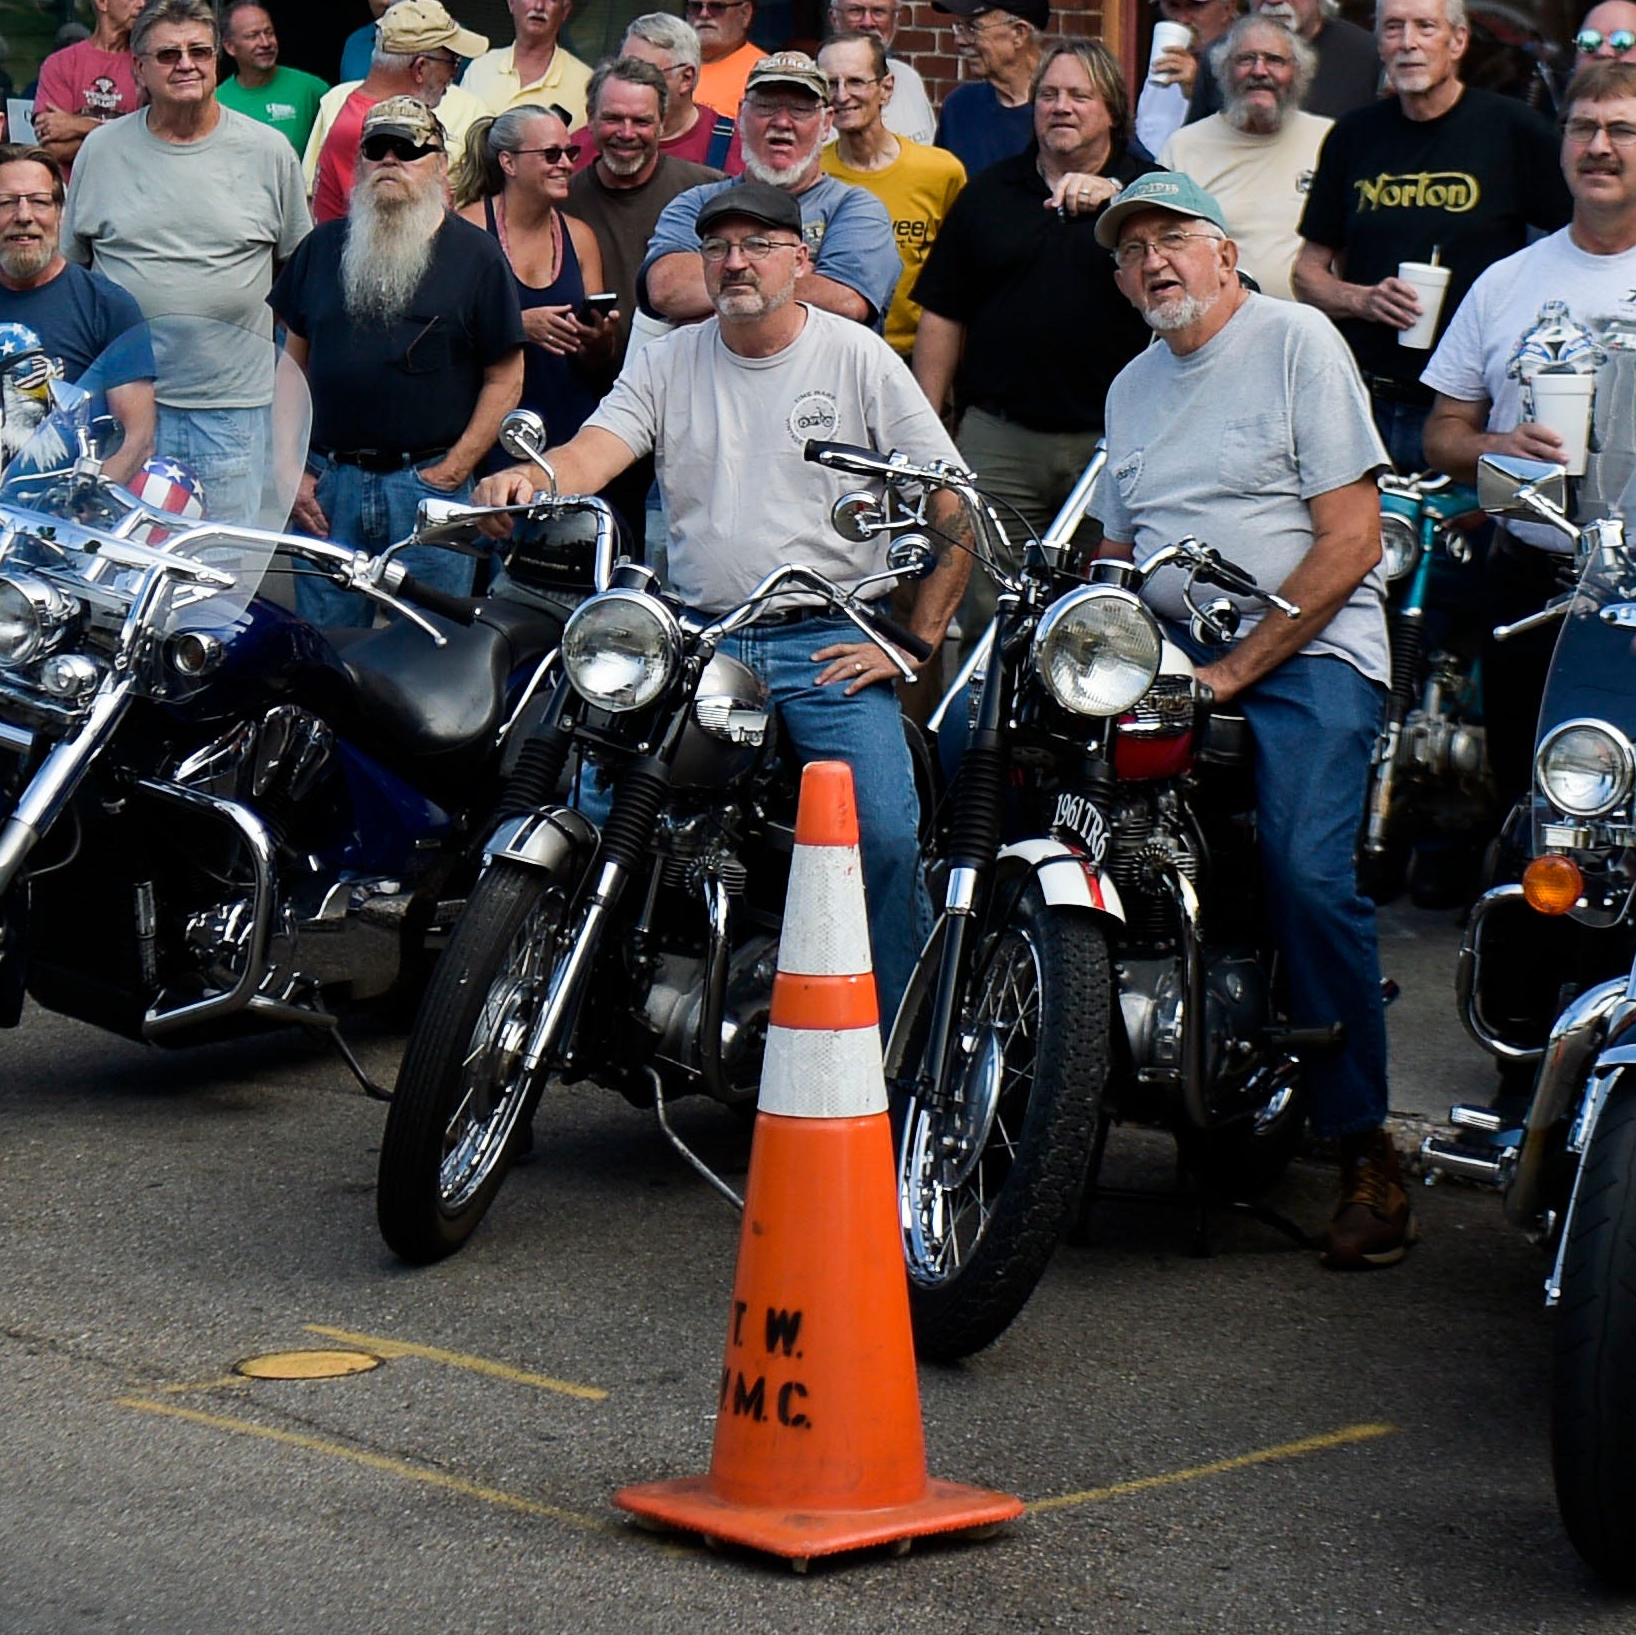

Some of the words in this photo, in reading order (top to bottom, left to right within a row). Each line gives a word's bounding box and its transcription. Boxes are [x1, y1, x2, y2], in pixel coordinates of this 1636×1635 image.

[1353, 172, 1480, 213] Norton
[1052, 793, 1085, 831] 1961
[1079, 801, 1111, 862] TR6
